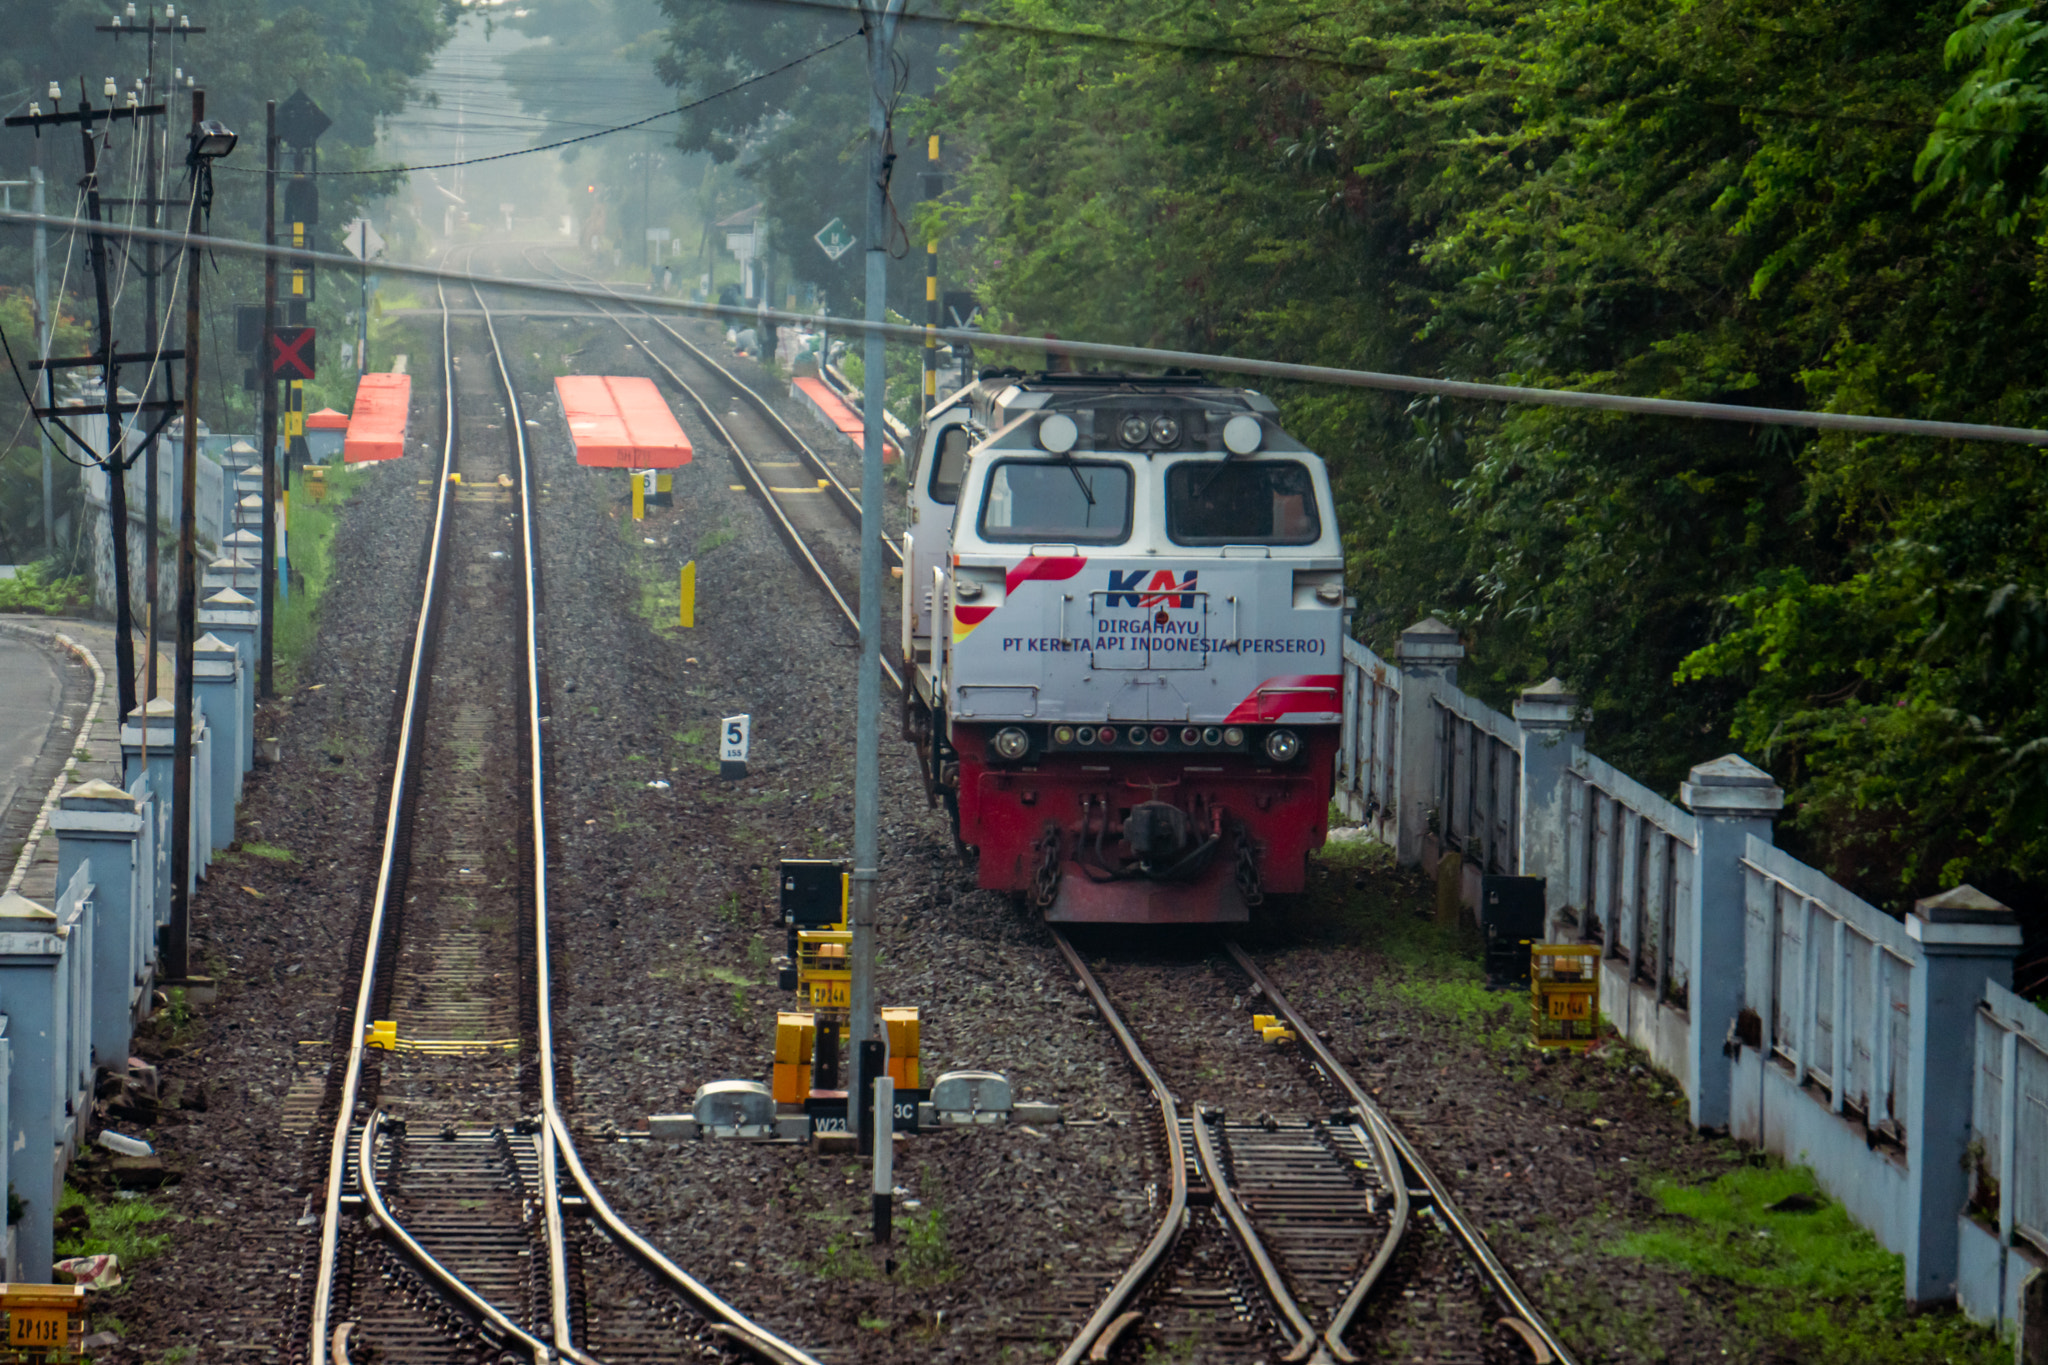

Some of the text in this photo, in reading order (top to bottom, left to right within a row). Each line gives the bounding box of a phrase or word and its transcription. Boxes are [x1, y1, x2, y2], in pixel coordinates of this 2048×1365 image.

[1105, 569, 1199, 609] KAI
[1098, 619, 1200, 635] DIRGAHAYU
[1002, 635, 1326, 656] PT KERETA API INDONESIA (PERSERO)
[727, 722, 743, 745] 5
[727, 749, 743, 758] 155
[815, 988, 845, 1003] ZP24A
[815, 1117, 847, 1132] W23
[17, 1318, 59, 1341] ZP13E
